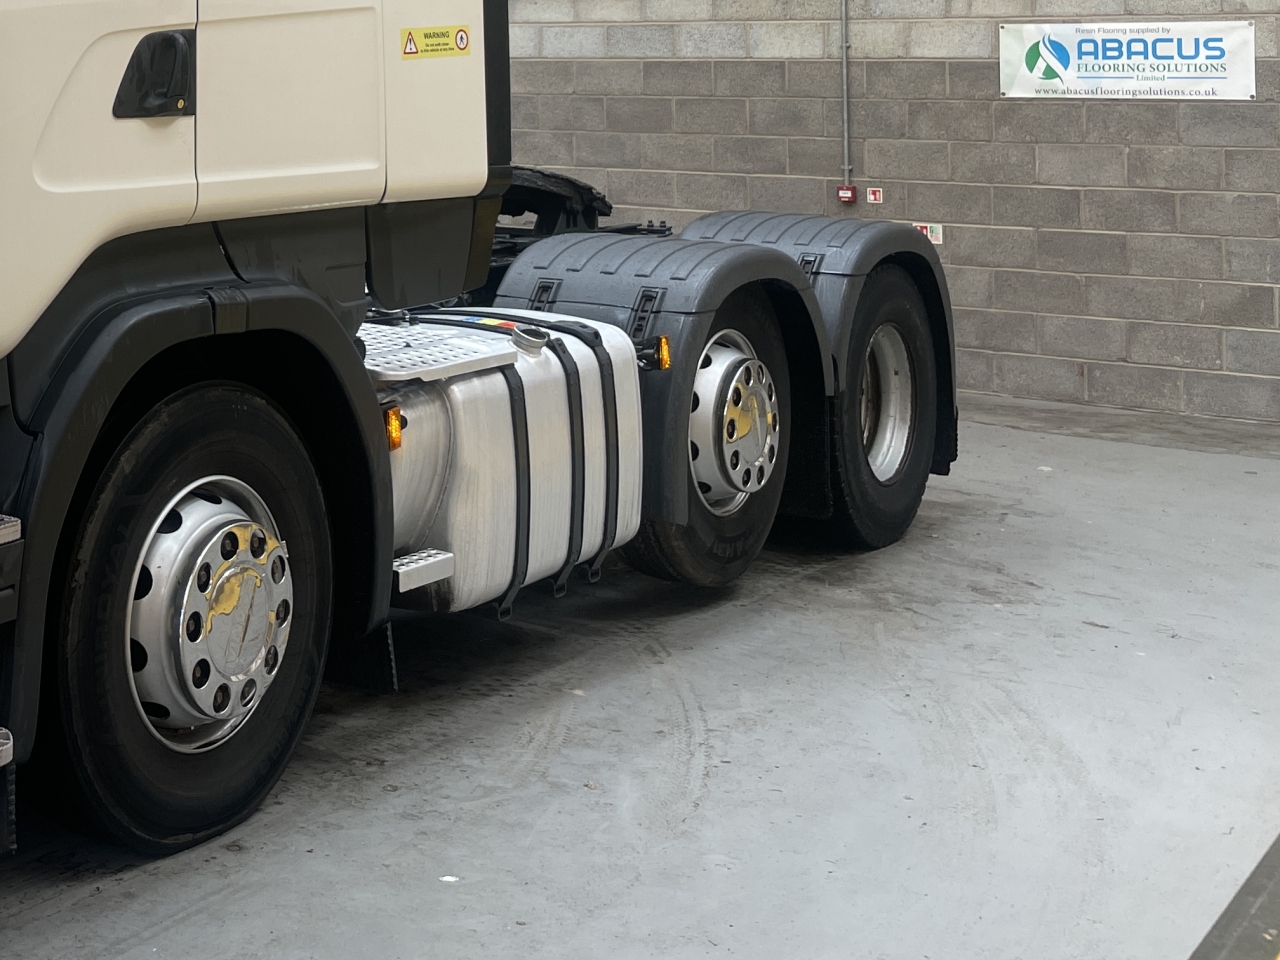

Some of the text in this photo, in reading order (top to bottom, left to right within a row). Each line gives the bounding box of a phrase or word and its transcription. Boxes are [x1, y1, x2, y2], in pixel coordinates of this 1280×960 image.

[1129, 26, 1160, 34] supplied
[1161, 26, 1171, 34] by
[423, 31, 450, 39] WARNING
[1077, 37, 1226, 61] ABACUS
[1077, 62, 1227, 73] FLOORING SOLUTIONS
[1136, 74, 1166, 82] Limited
[1034, 86, 1218, 98] www.abacusflooringsolutions.co.uk
